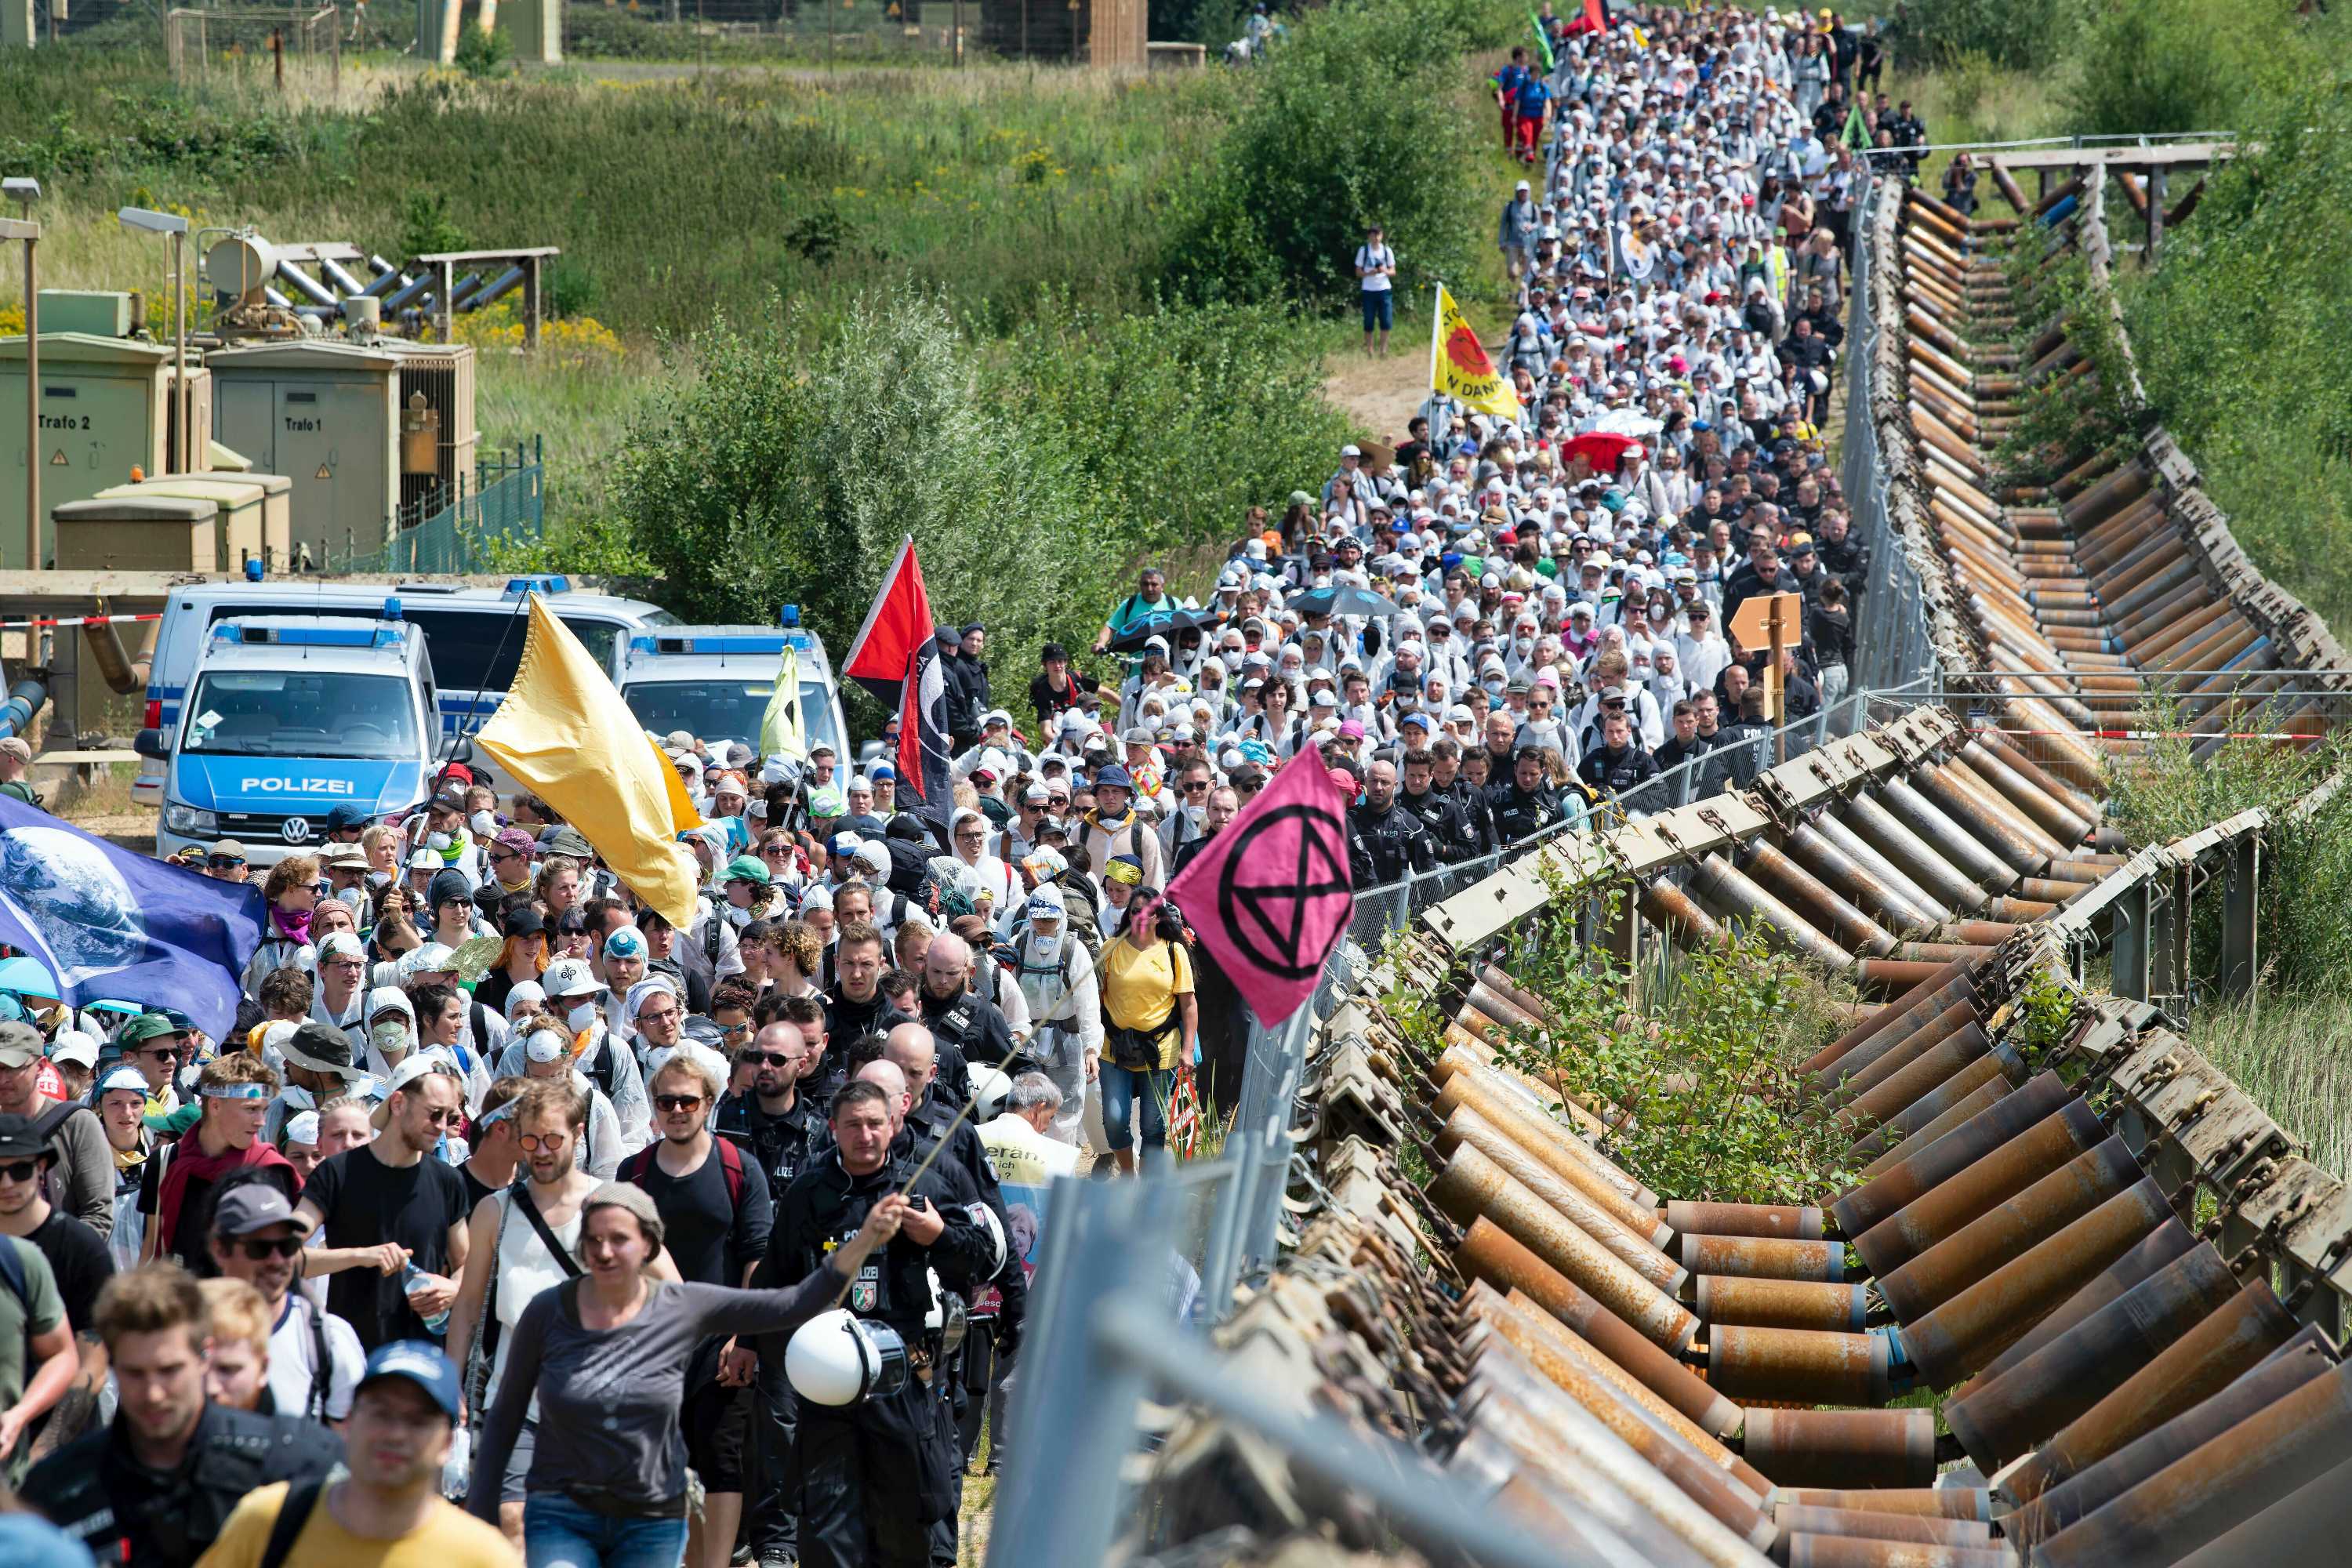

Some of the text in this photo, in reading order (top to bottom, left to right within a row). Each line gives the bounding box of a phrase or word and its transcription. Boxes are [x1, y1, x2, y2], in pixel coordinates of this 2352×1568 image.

[38, 415, 90, 430] Trafo 2
[285, 417, 321, 431] Trafo 1
[241, 778, 354, 794] POLIZEI
[947, 1010, 970, 1029] POLIZEI
[998, 1160, 1015, 1169] ich
